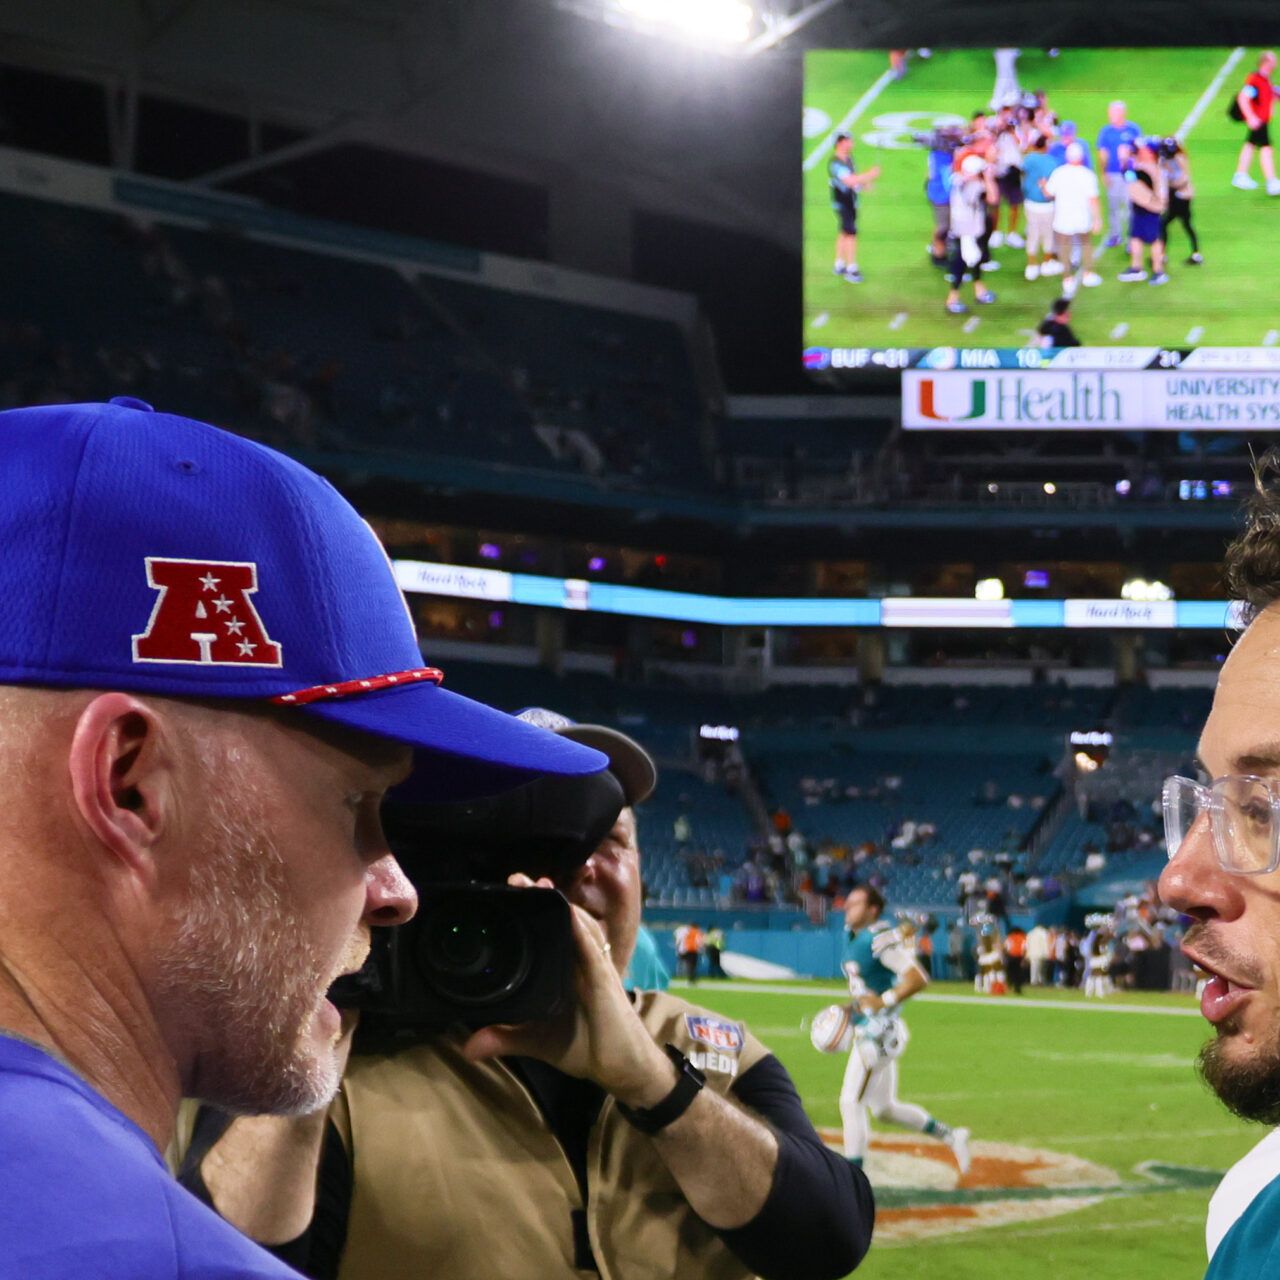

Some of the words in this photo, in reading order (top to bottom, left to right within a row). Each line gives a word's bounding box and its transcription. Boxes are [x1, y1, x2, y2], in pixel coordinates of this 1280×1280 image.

[831, 348, 870, 368] BUF
[961, 348, 1001, 368] MIA
[1166, 378, 1279, 396] UNIVERSITY
[1166, 403, 1240, 421] HEALTH
[695, 1024, 738, 1048] NFL
